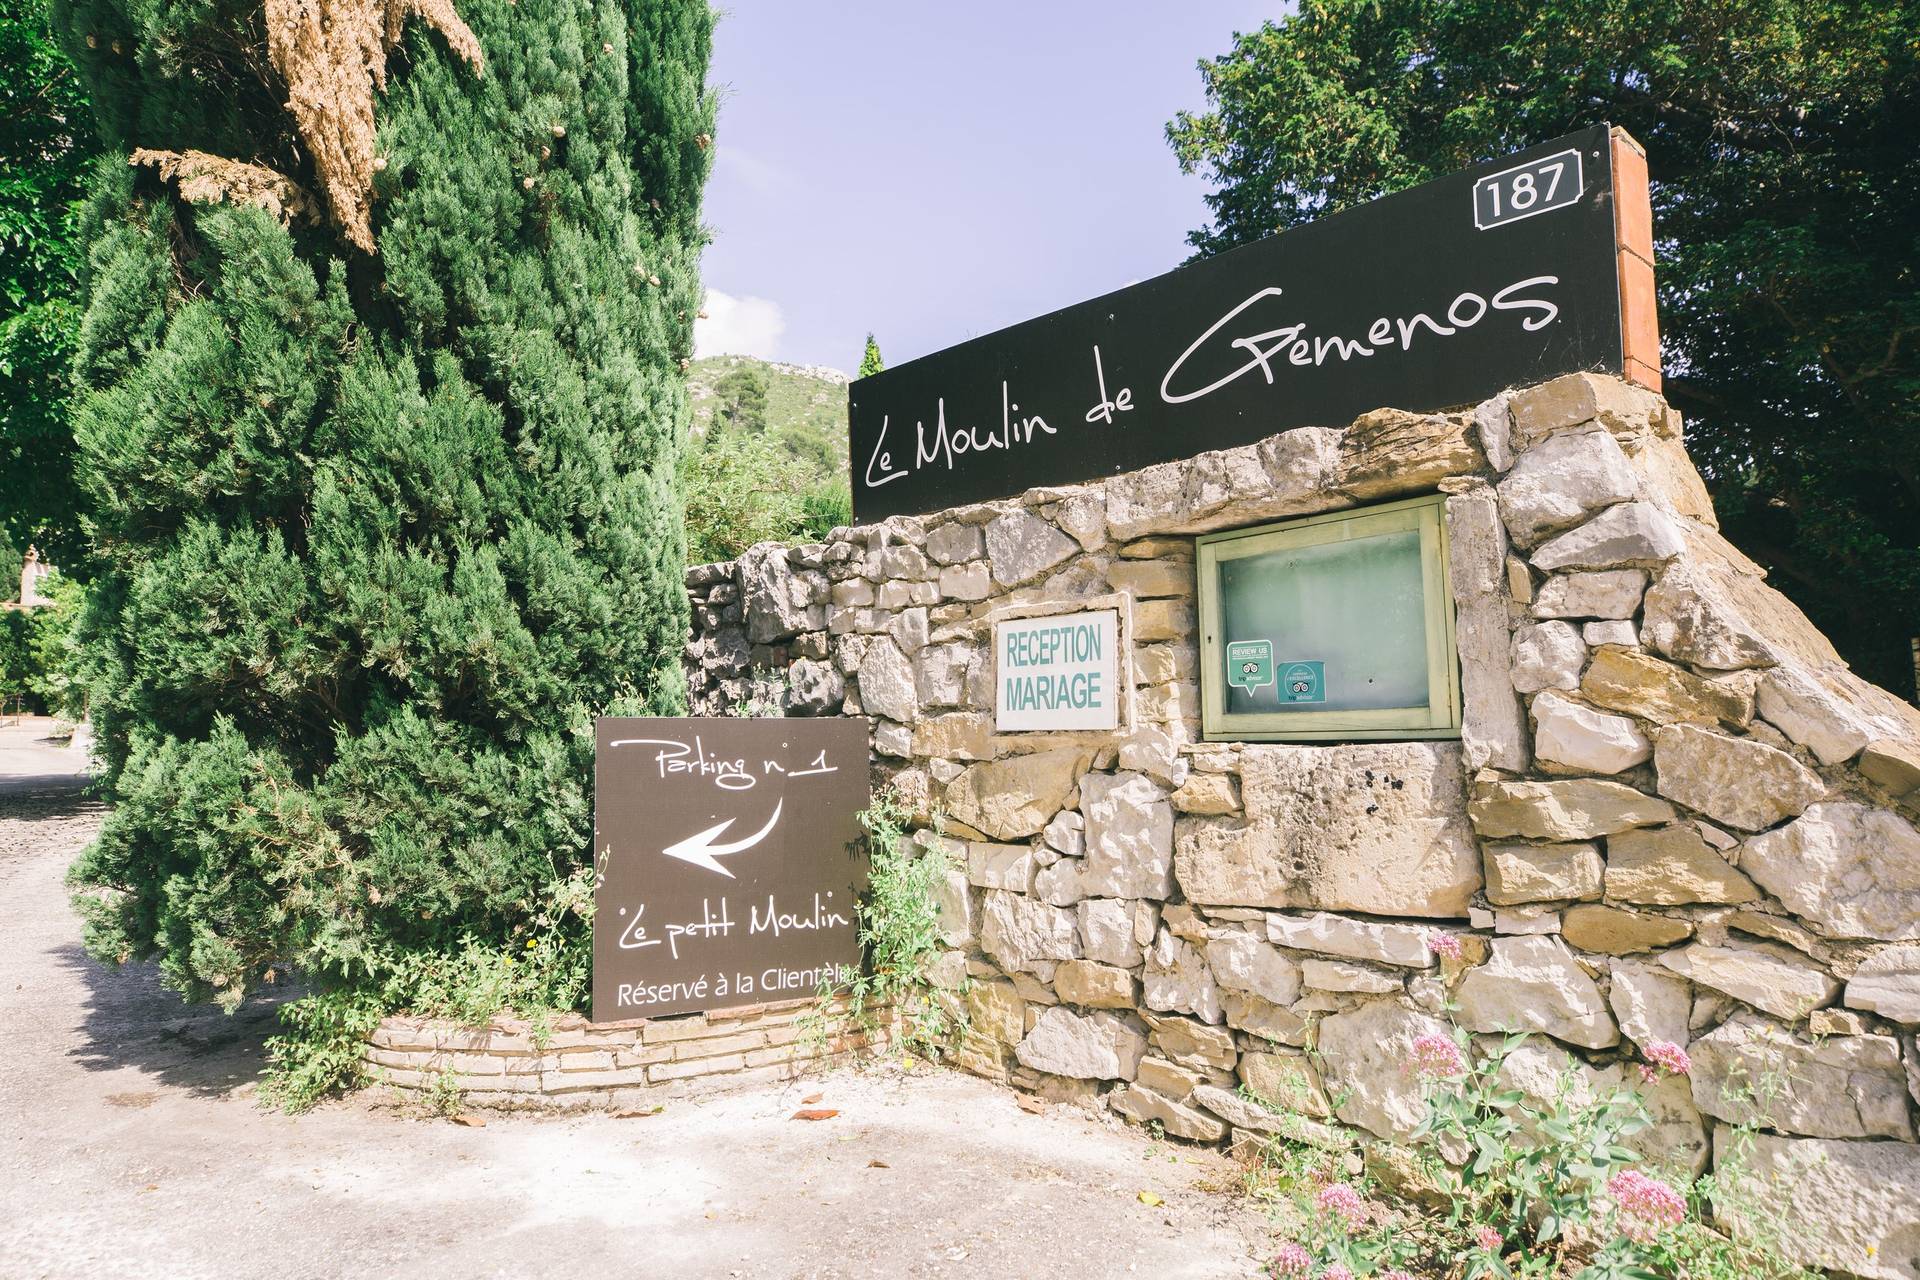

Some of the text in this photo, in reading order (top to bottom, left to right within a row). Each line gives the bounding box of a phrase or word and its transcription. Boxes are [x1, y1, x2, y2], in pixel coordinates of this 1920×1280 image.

[1486, 161, 1565, 218] 187
[865, 275, 1560, 488] Le Moulin de Gemenos
[1006, 623, 1102, 668] RECEPTION
[1006, 671, 1102, 712] MARIAGE
[610, 735, 757, 790] Parking
[619, 893, 849, 960] Le petit Moulin
[617, 979, 709, 1007] Réservé
[714, 972, 729, 996] à
[735, 972, 754, 995] la
